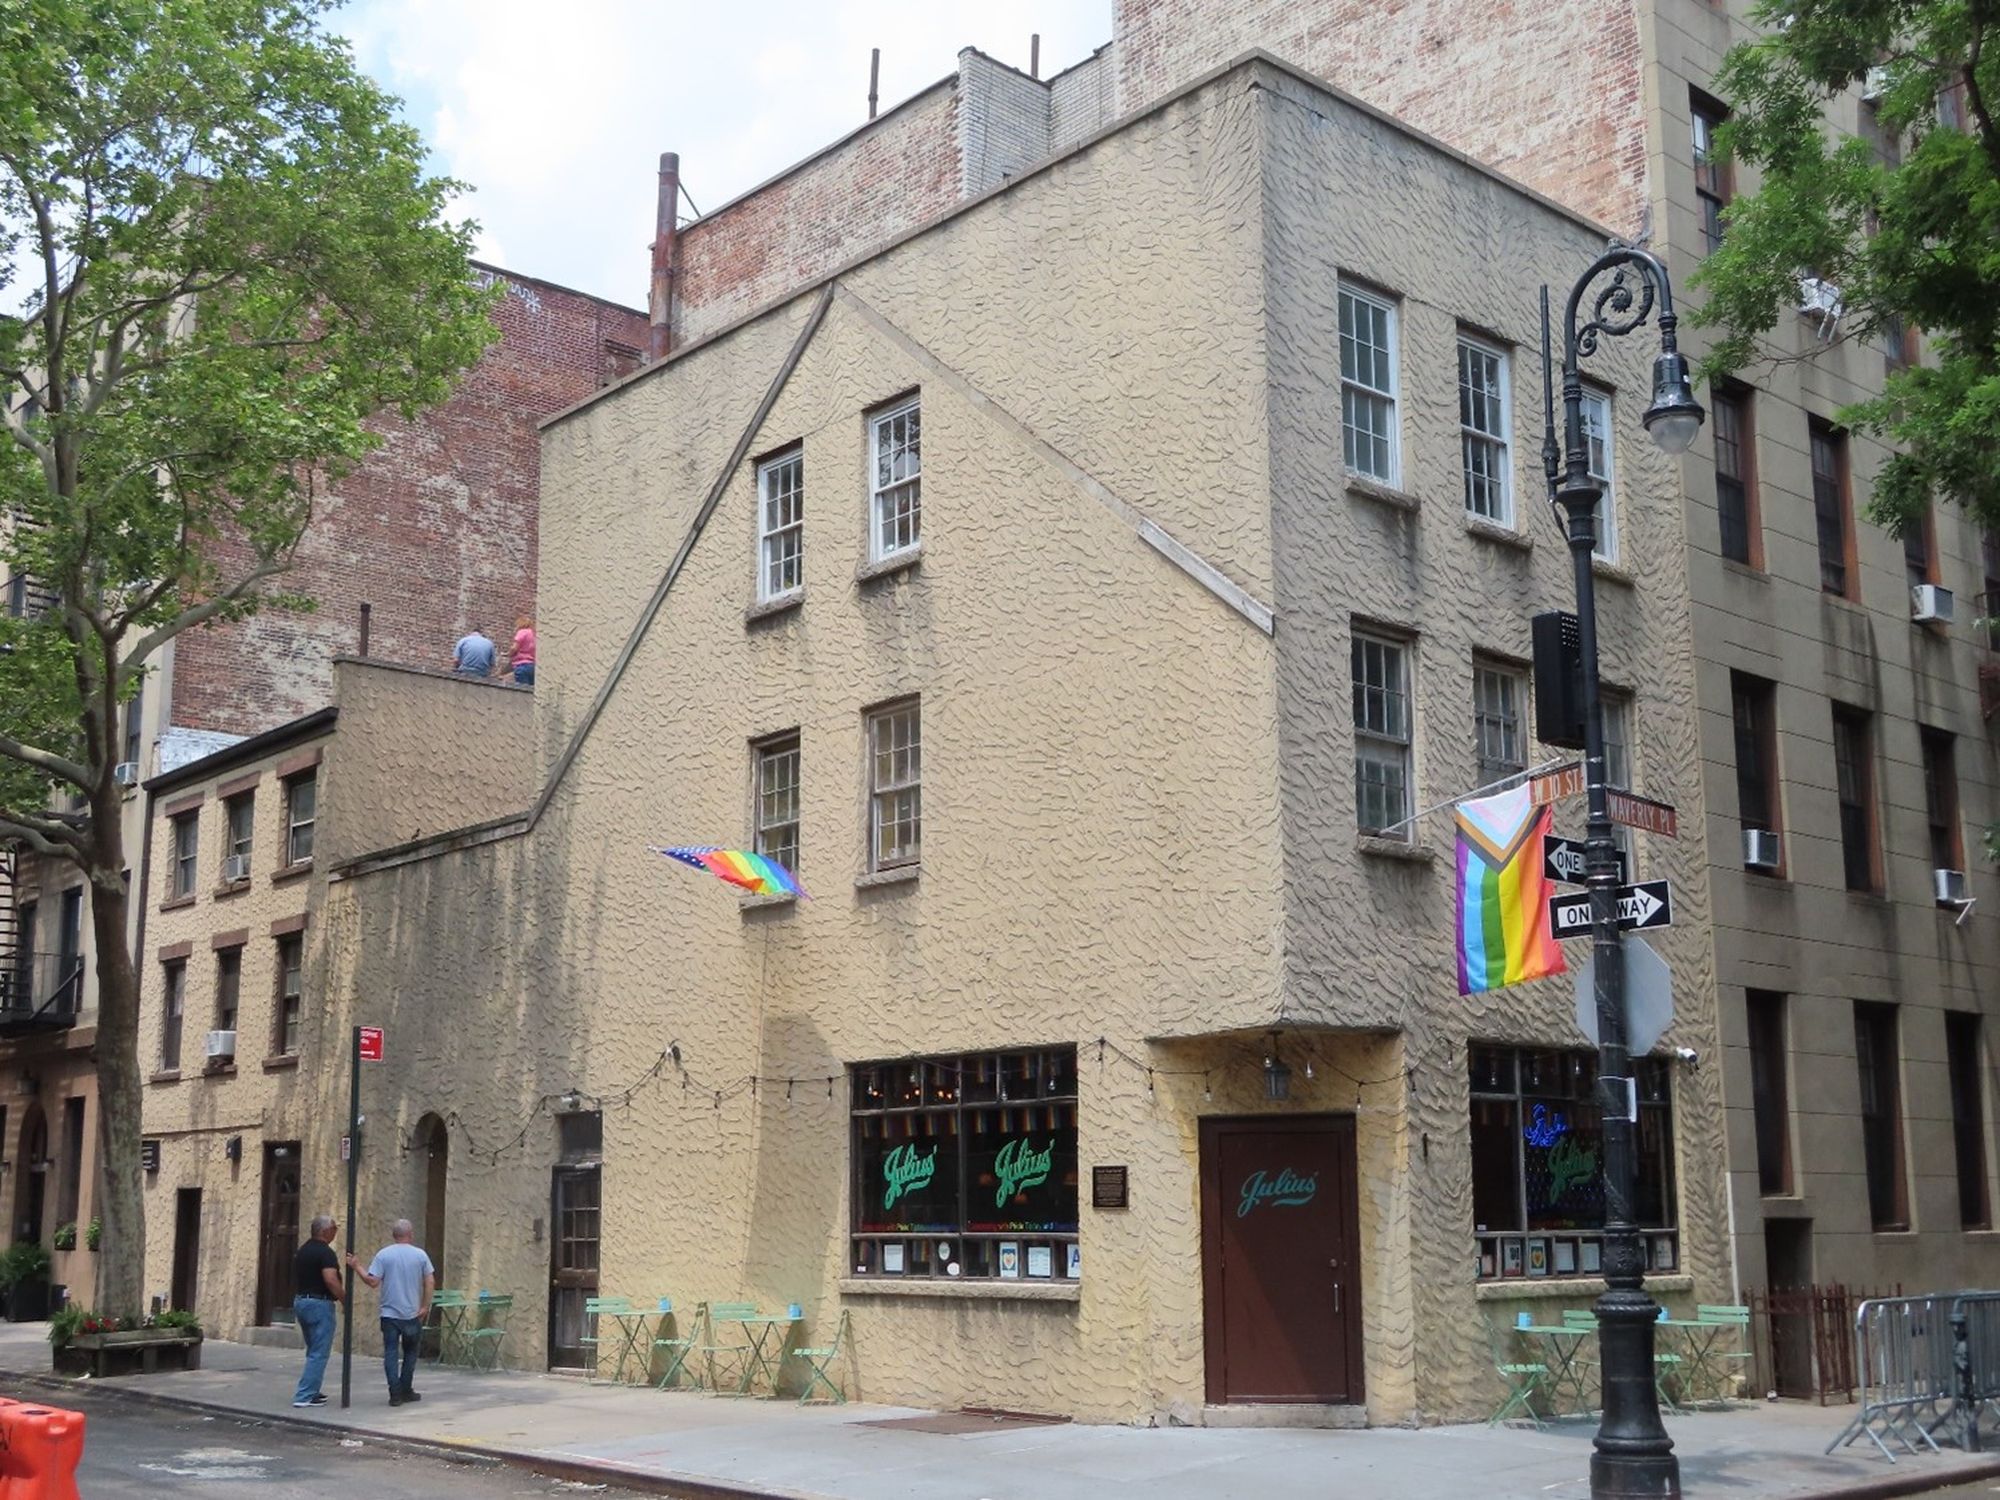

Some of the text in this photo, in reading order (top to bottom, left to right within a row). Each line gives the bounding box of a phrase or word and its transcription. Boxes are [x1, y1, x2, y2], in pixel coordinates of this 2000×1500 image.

[1534, 768, 1579, 804] W 10 ST
[1608, 793, 1672, 835] WAVERLY PL
[1556, 851, 1580, 871] ONE
[1567, 897, 1651, 924] ON WAY
